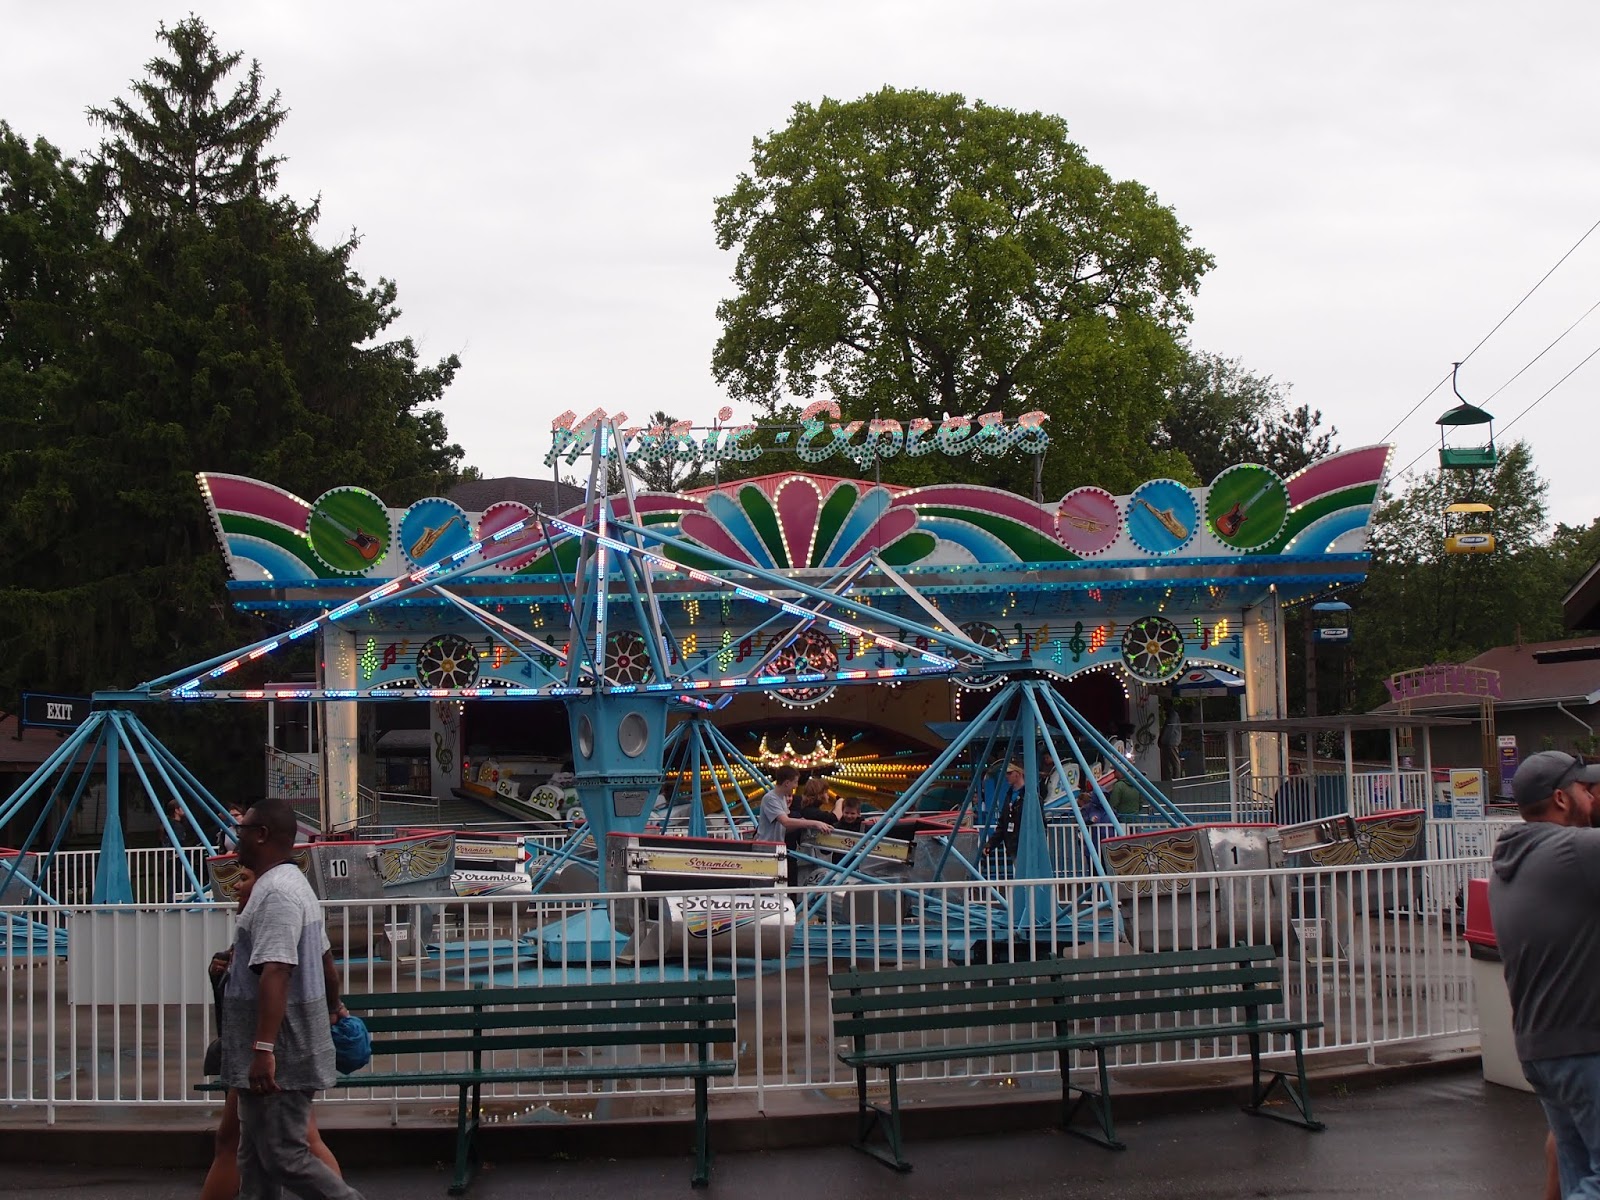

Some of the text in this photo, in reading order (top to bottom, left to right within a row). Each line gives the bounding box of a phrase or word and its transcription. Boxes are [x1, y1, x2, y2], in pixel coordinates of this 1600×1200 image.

[46, 702, 73, 720] EXIT
[455, 845, 494, 855] Scrambler
[1231, 846, 1238, 864] 1
[332, 860, 347, 877] 10
[685, 857, 743, 870] Scrambler
[450, 871, 527, 883] Scrambler
